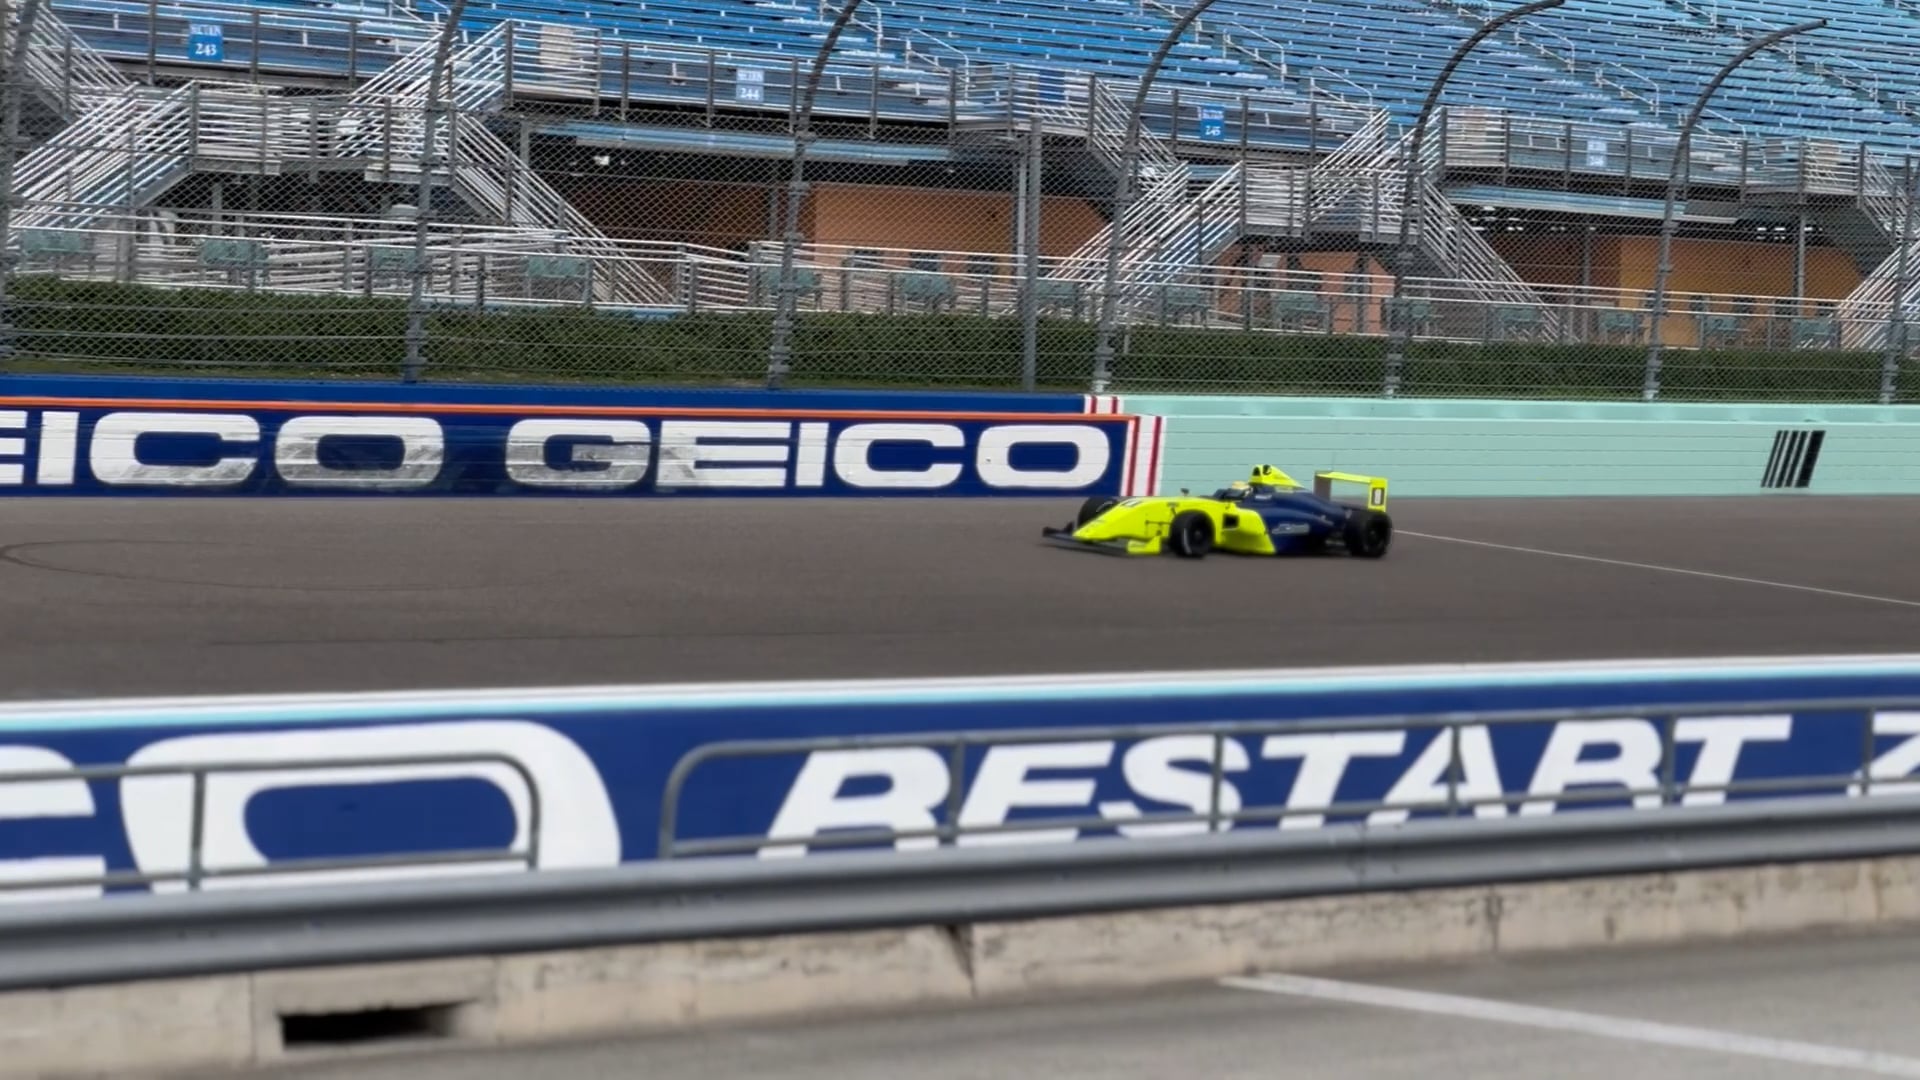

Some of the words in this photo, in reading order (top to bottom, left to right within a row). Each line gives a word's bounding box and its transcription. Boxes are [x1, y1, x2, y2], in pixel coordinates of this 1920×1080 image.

[194, 43, 218, 56] 243
[739, 87, 760, 101] 244
[0, 410, 445, 487] ICO
[505, 418, 1111, 489] GEICO
[757, 713, 1793, 861] RESTART
